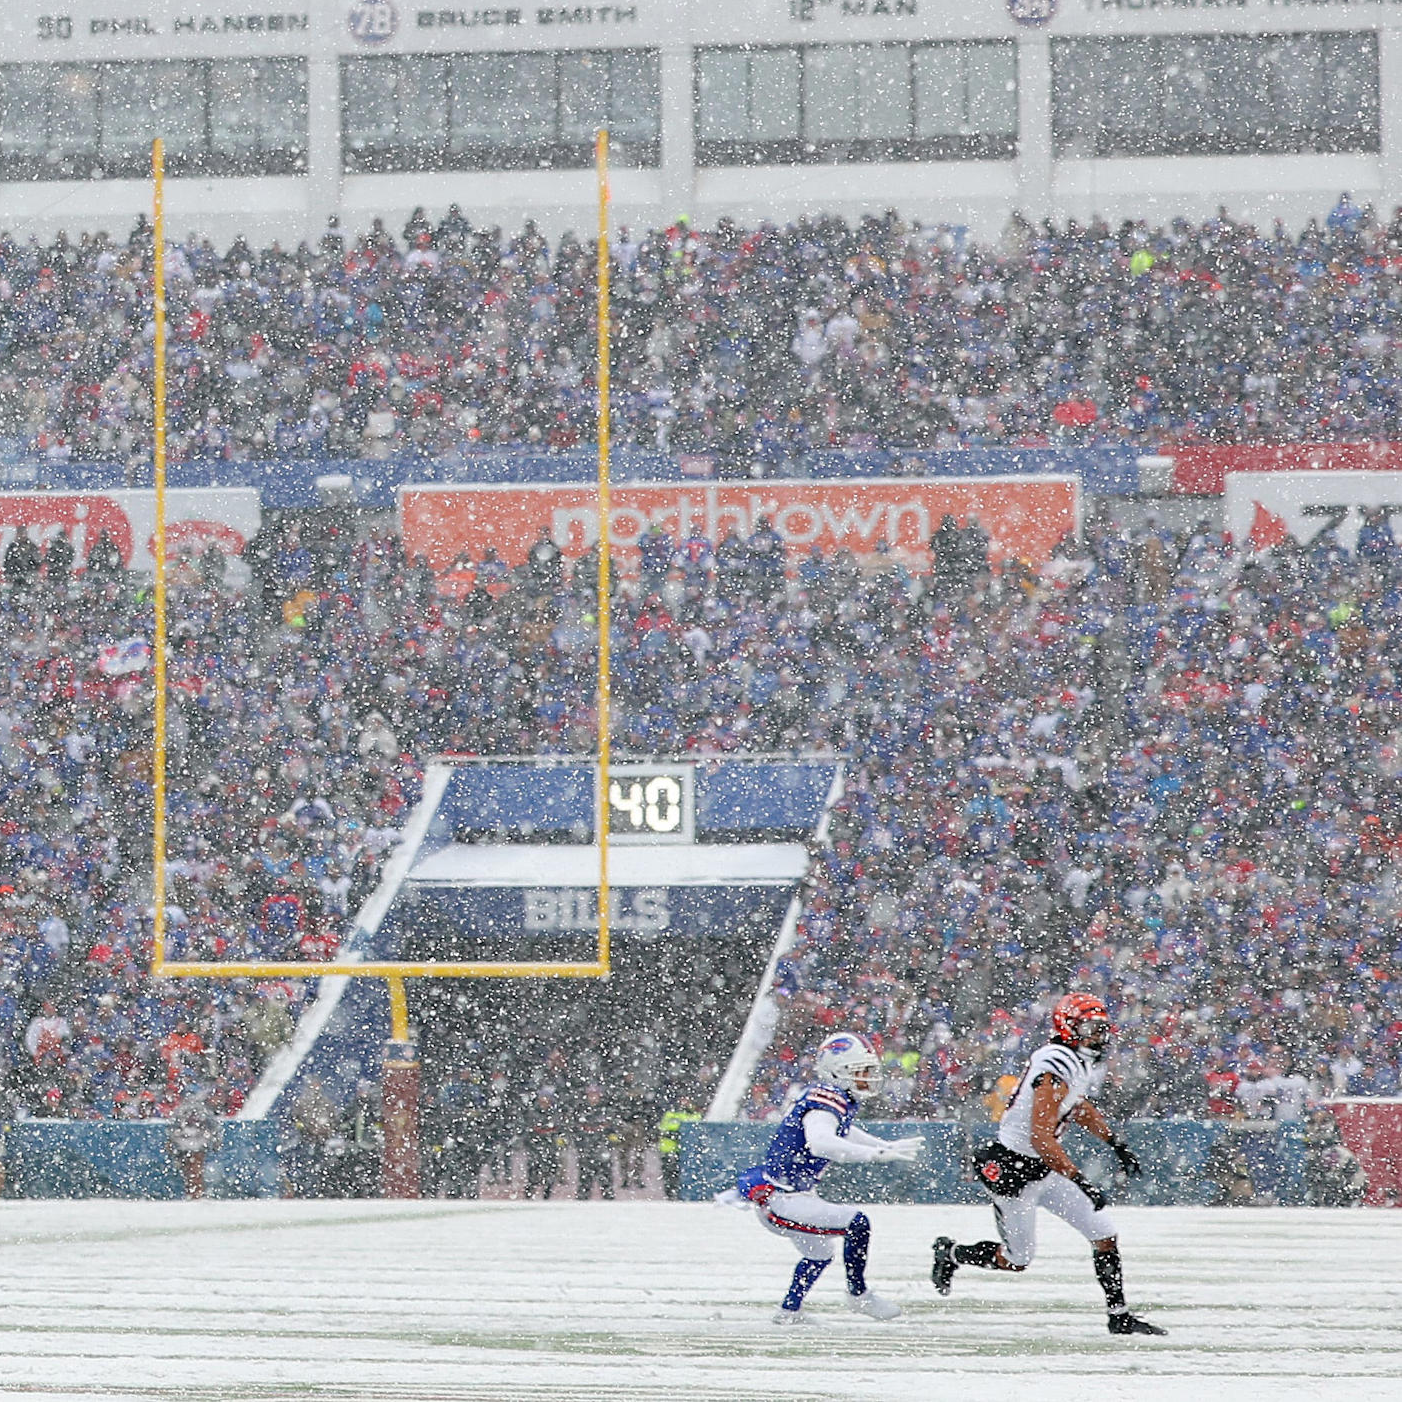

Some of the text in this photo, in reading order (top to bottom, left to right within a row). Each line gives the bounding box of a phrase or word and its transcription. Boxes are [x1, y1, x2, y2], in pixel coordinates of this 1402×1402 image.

[351, 3, 392, 35] 78
[417, 4, 637, 28] BRUCE SMITH
[608, 776, 681, 833] 40
[524, 890, 671, 930] BILLS
